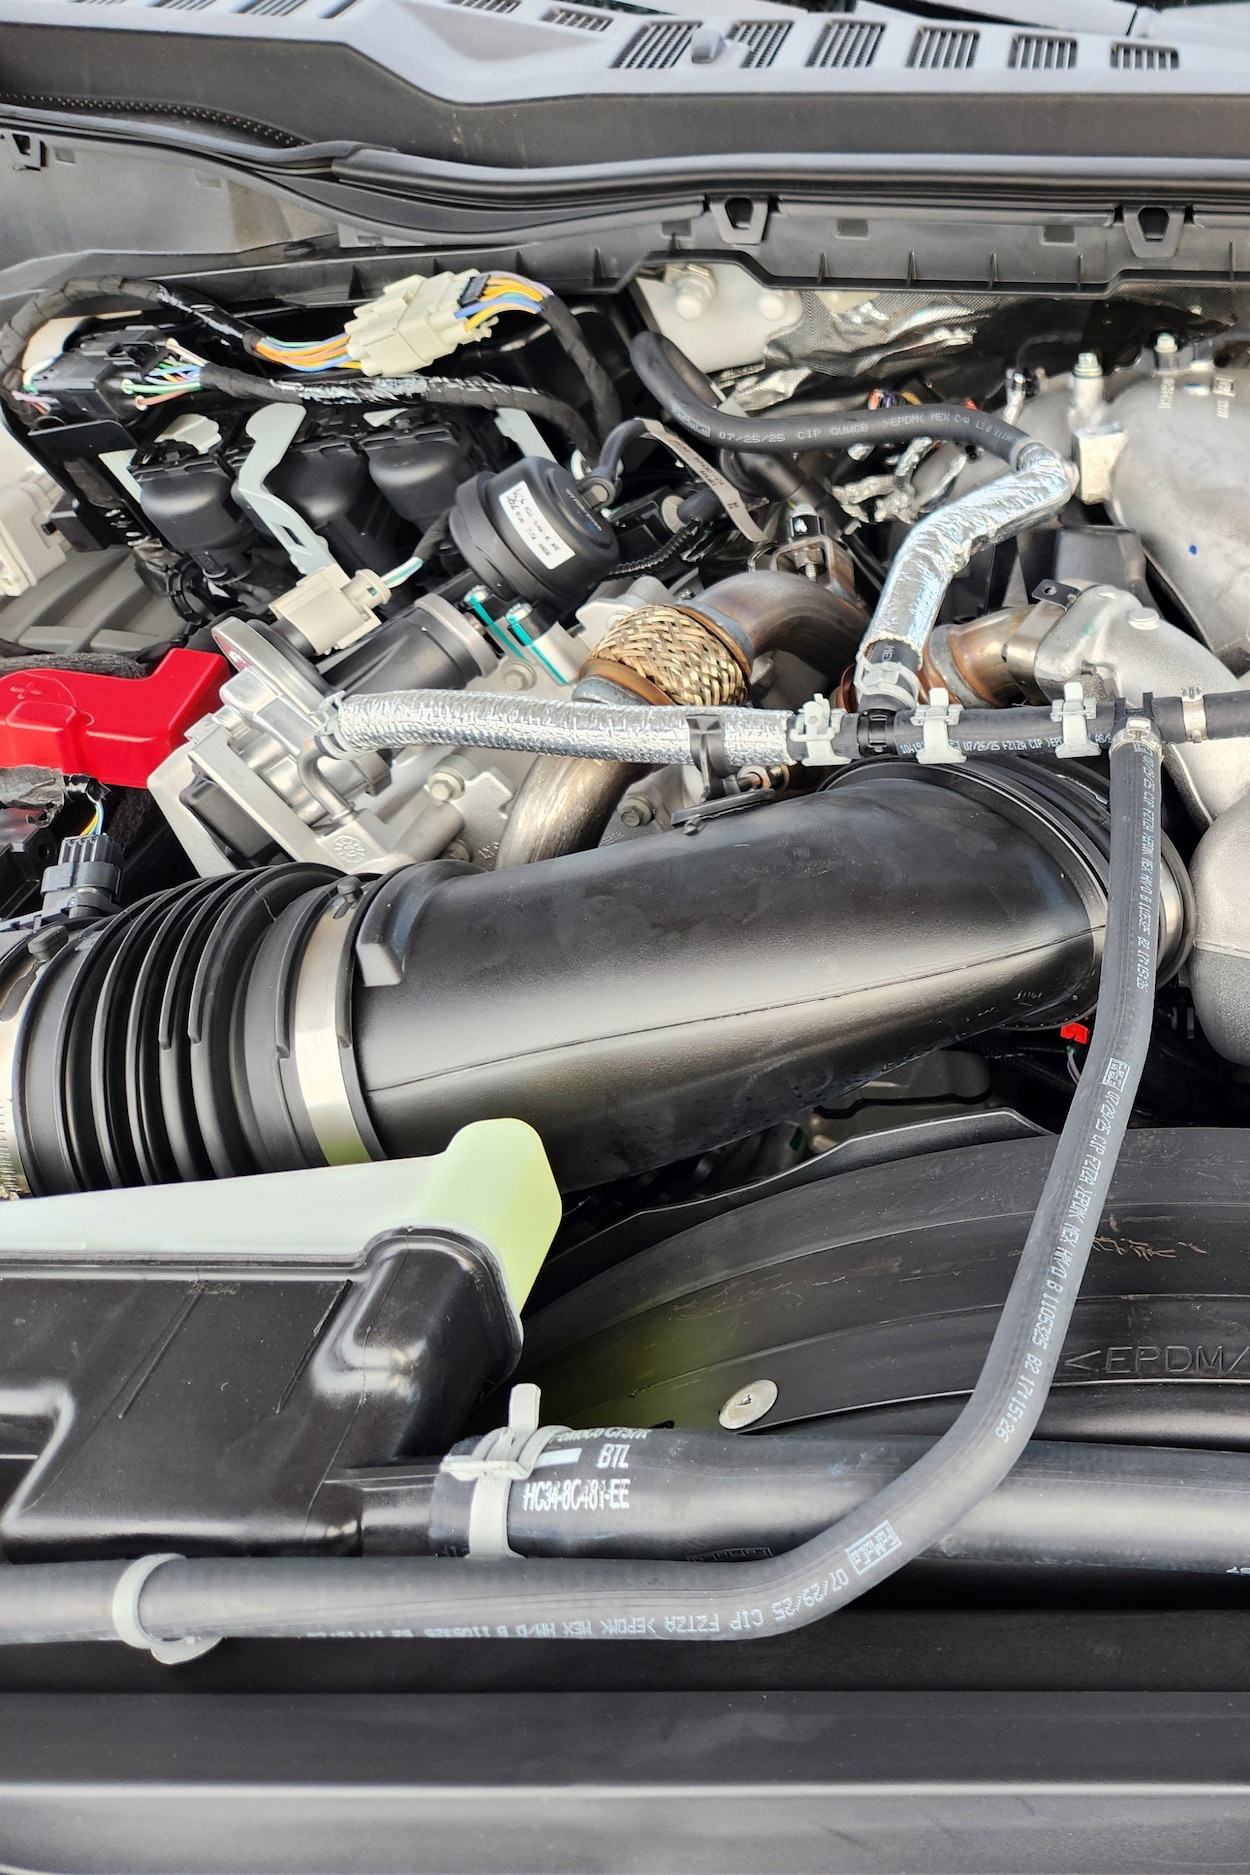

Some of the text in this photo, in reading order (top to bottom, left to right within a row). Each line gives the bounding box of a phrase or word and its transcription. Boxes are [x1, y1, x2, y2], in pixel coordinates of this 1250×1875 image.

[717, 430, 786, 444] 07/25/25
[797, 428, 822, 440] CIP
[1028, 738, 1043, 749] CIP
[1143, 791, 1153, 805] CIP
[1093, 1089, 1120, 1135] 07/29/25
[1088, 1134, 1107, 1155] CIP
[1058, 1222, 1081, 1248] MEX
[1032, 1292, 1060, 1349] 1105325
[994, 1376, 1034, 1444] 17:15:26
[596, 1443, 630, 1469] BTL
[770, 1567, 849, 1623] 07/29/25
[561, 1620, 591, 1636] MEX
[729, 1608, 764, 1632] CIP
